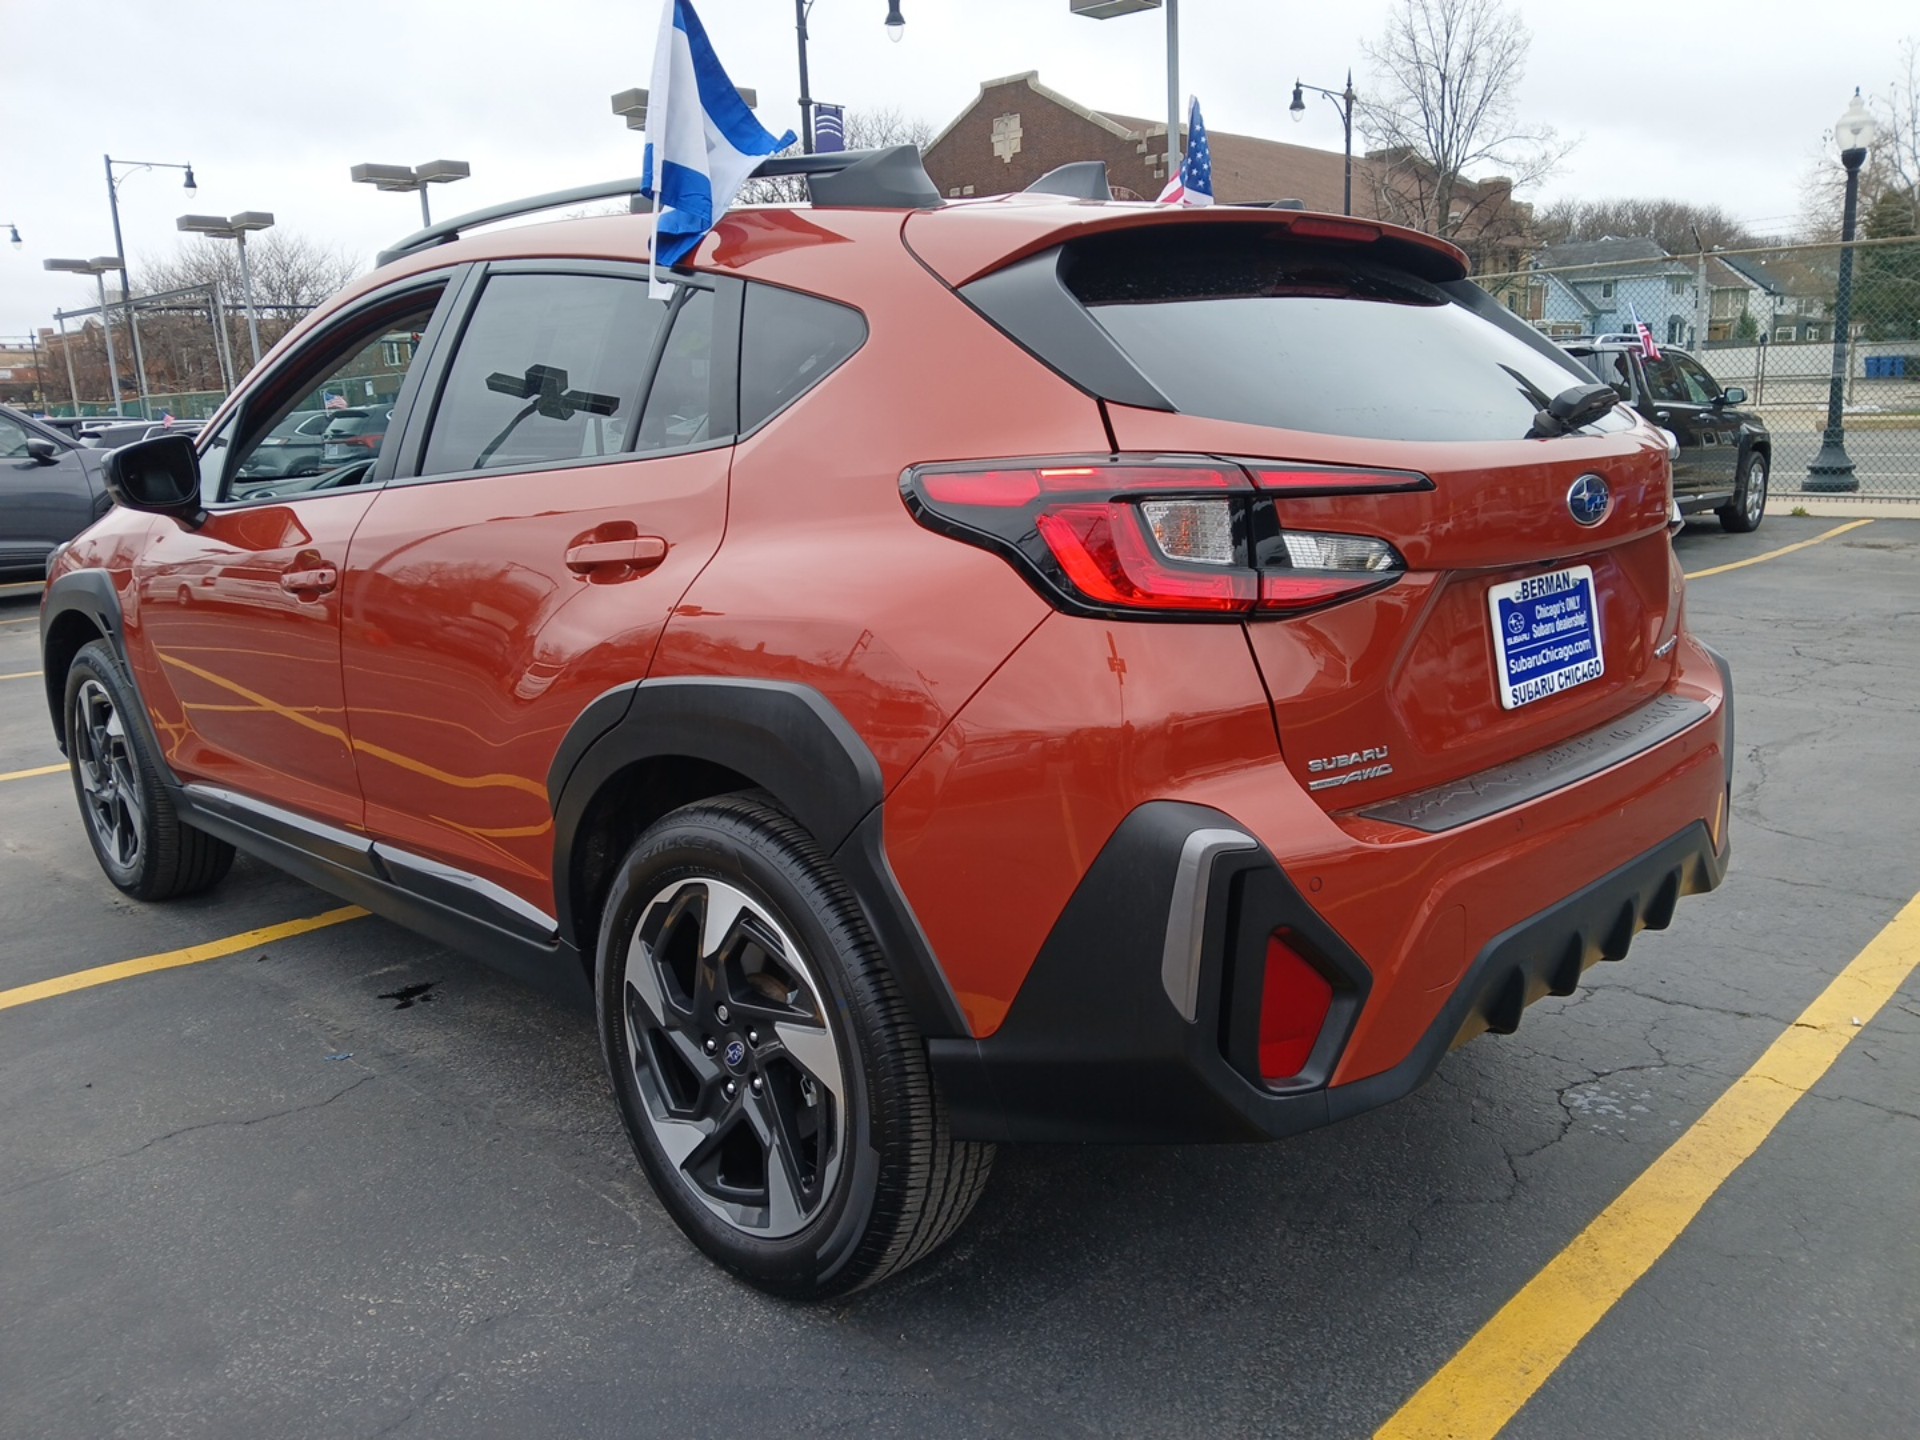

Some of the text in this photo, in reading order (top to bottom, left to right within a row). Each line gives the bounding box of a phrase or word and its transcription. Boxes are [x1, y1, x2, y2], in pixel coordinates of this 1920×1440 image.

[1521, 572, 1570, 600] BERMAN
[1535, 595, 1580, 620] Chicago's ONLY
[1532, 622, 1555, 639] Subaru
[1509, 639, 1591, 674] SubaruChicago.com
[1512, 660, 1601, 706] SUBARU CHICAGO
[1308, 745, 1388, 772] SUBARU
[1343, 764, 1393, 784] AWD
